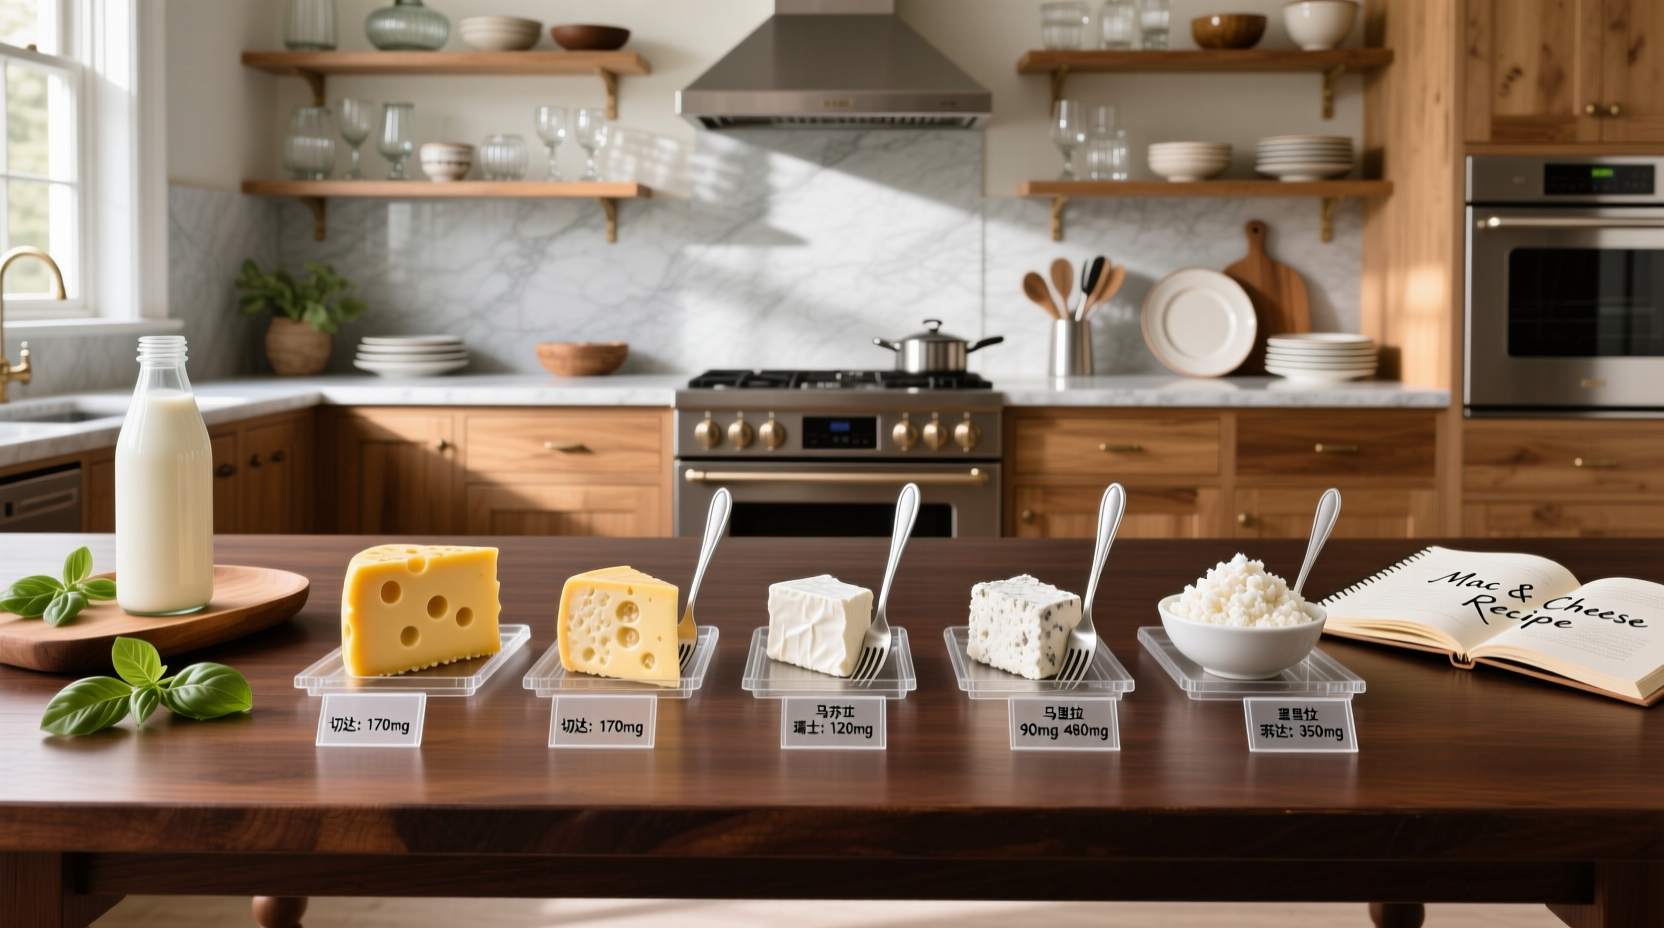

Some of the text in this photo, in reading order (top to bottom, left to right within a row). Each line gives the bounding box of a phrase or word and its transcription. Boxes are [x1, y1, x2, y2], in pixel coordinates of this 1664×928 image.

[1427, 571, 1648, 628] Mac & Cheese
[1461, 594, 1574, 629] Recipe
[367, 718, 410, 735] 170mg
[600, 719, 644, 737] 170mg
[830, 721, 873, 739] 120mg
[1020, 723, 1109, 741] 90mg 480mg
[1299, 724, 1344, 741] 350mg
